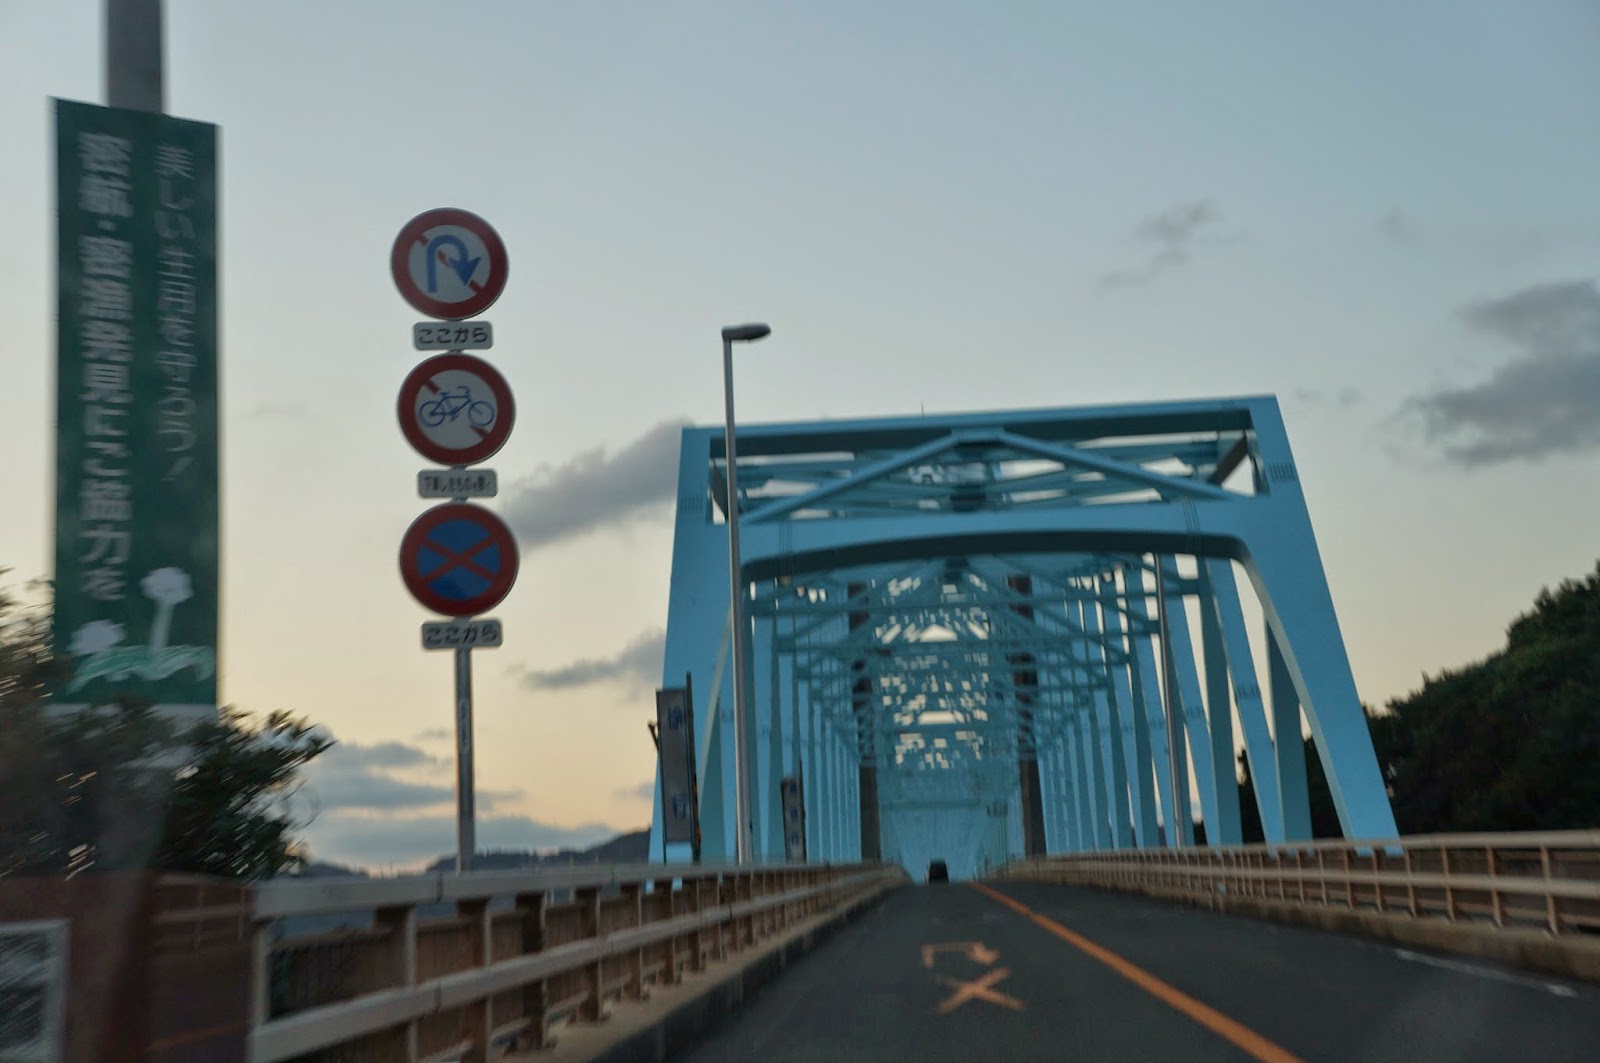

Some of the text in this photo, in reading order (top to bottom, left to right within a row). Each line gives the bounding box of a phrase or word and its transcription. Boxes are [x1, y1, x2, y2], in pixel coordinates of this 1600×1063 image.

[418, 327, 488, 344] ここから
[427, 625, 498, 644] ここから
